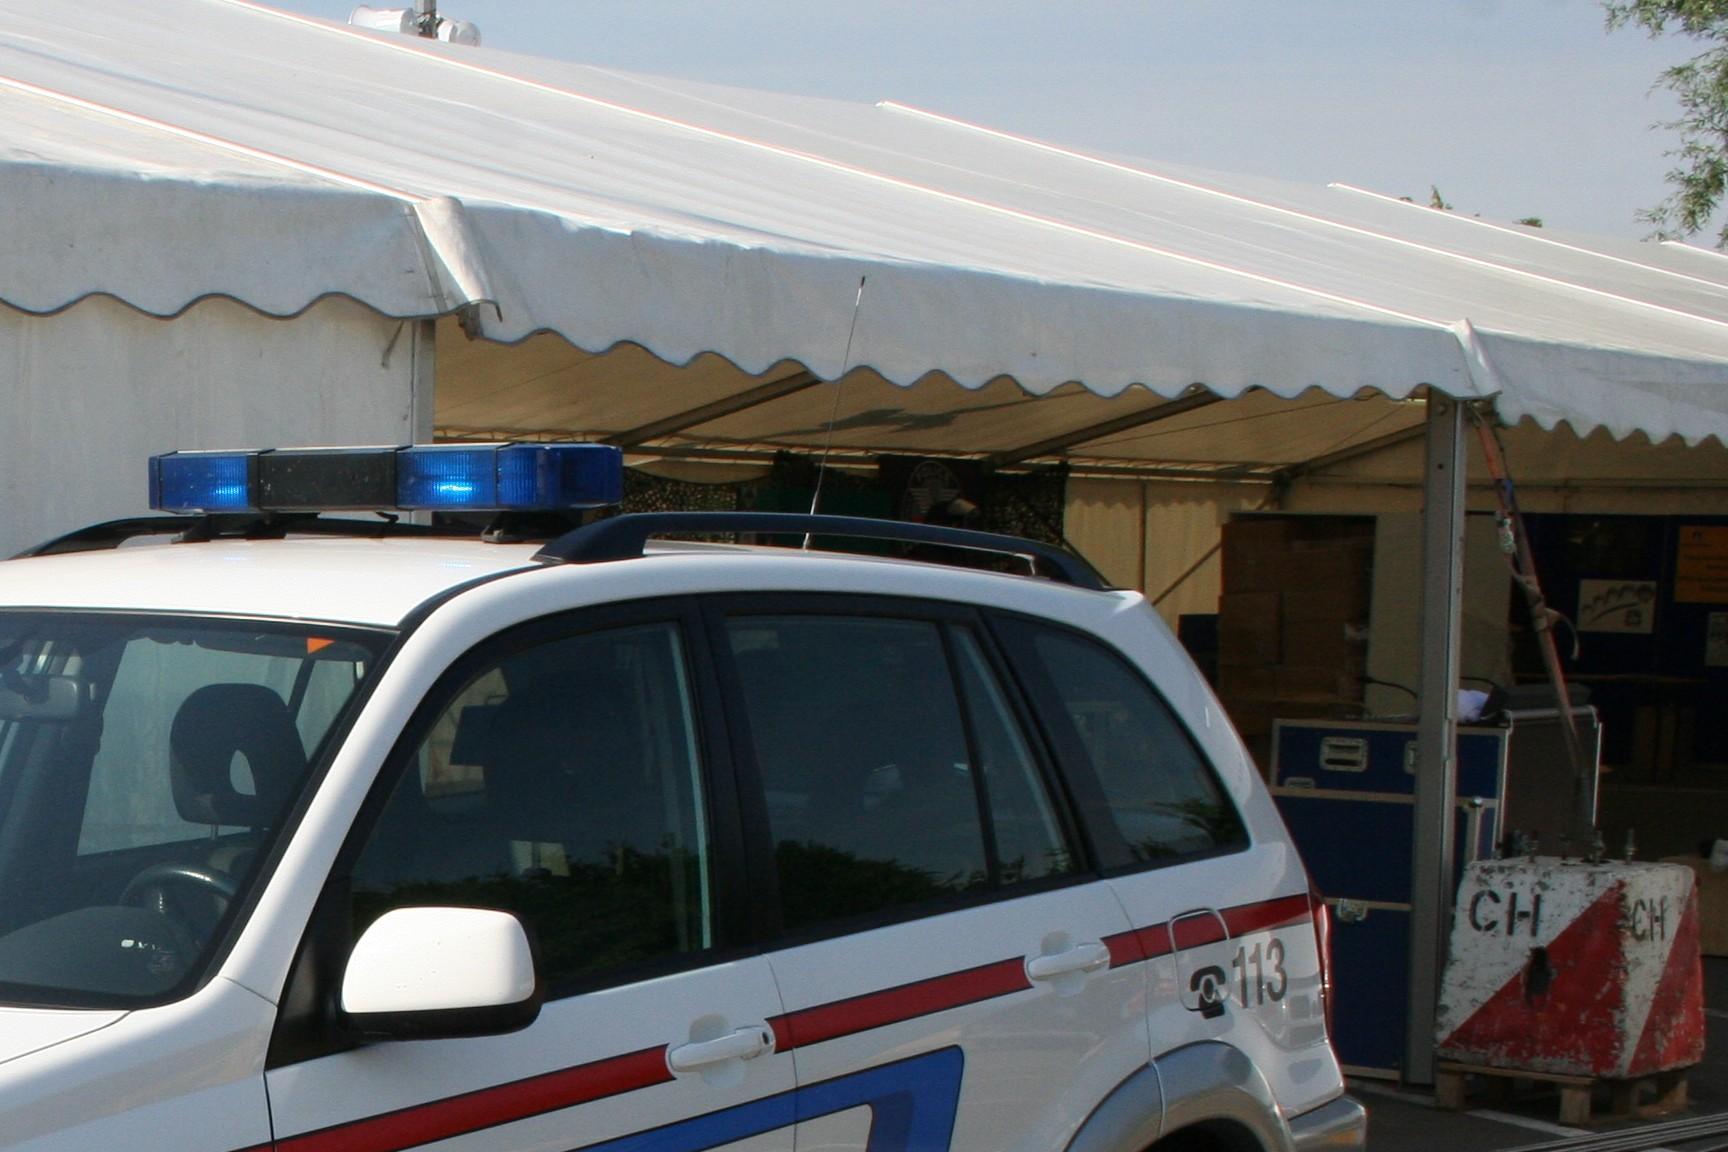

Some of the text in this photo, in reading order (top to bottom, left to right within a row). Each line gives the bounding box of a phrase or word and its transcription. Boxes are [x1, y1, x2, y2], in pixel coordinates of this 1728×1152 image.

[1469, 889, 1541, 937] CH
[1632, 896, 1666, 942] CH
[1232, 937, 1287, 1008] 113
